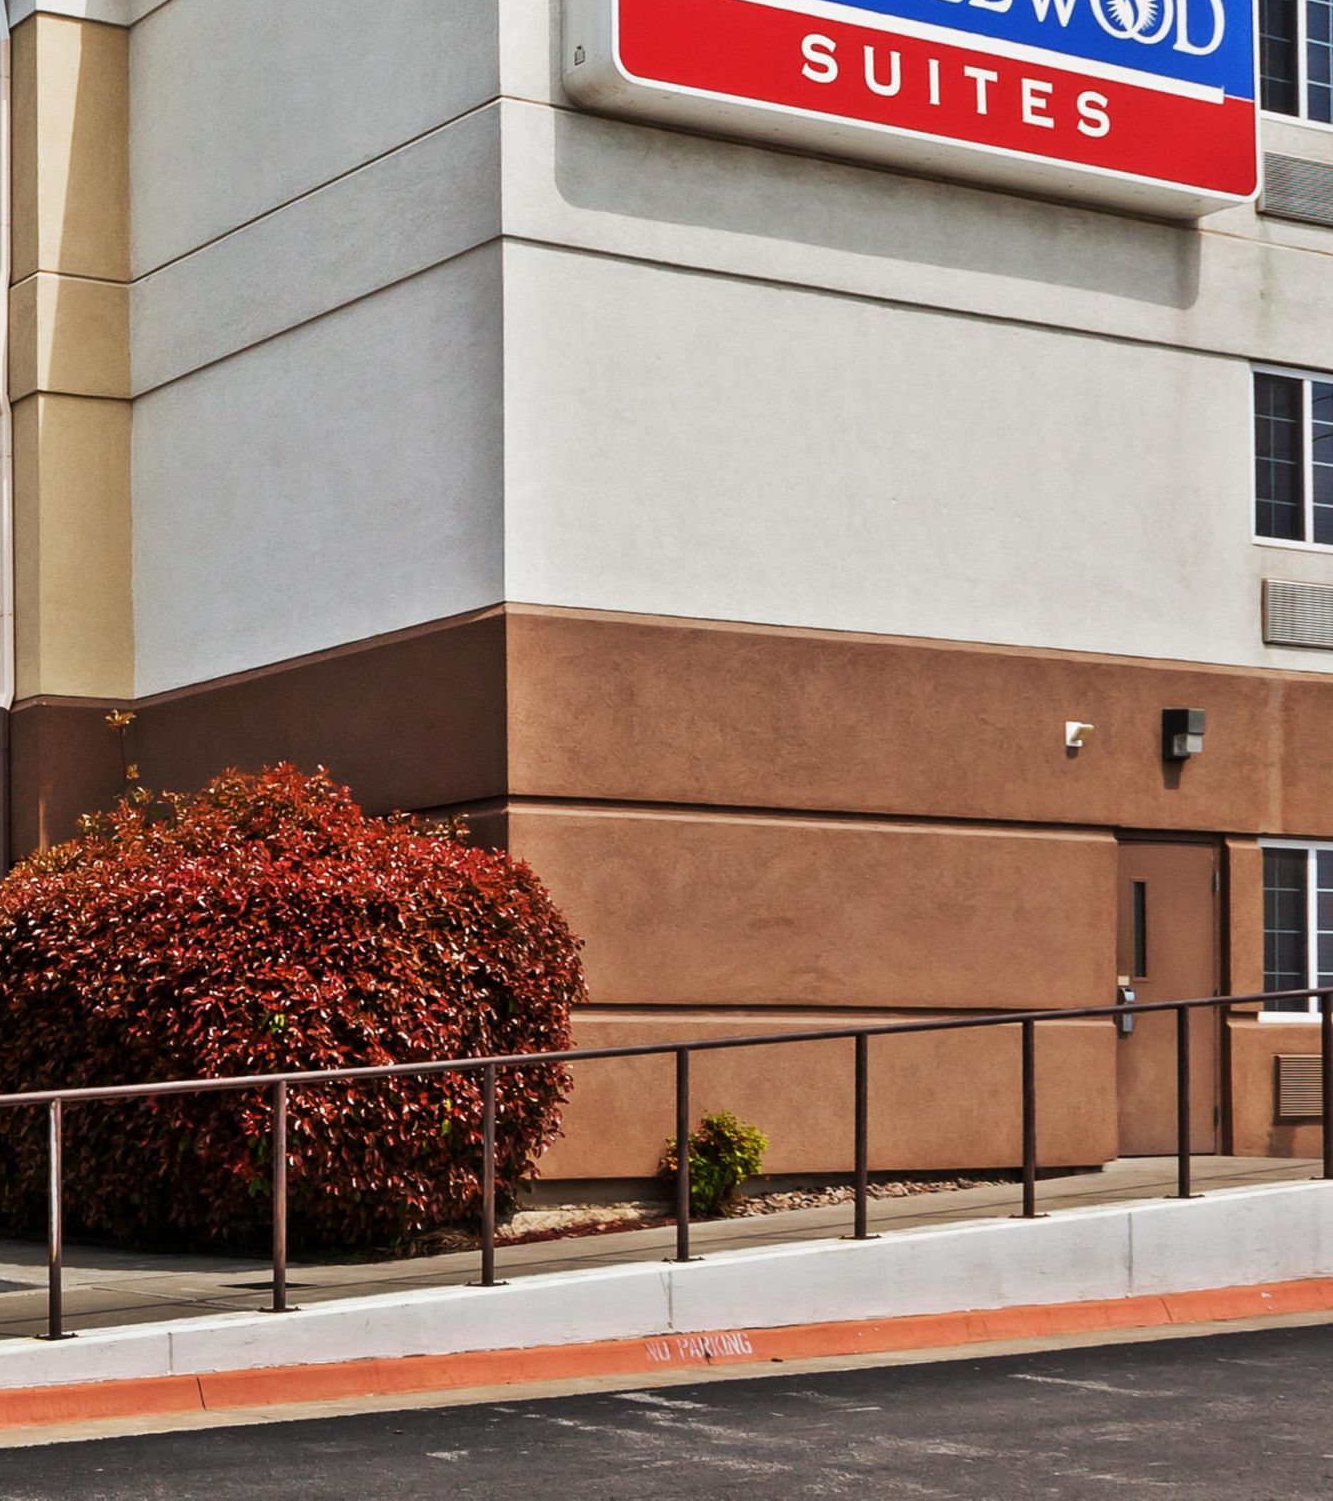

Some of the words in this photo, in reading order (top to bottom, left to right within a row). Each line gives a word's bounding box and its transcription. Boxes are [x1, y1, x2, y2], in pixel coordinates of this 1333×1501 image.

[800, 33, 1110, 138] SUITES
[645, 1340, 671, 1361] NO
[677, 1332, 753, 1359] PARKING
